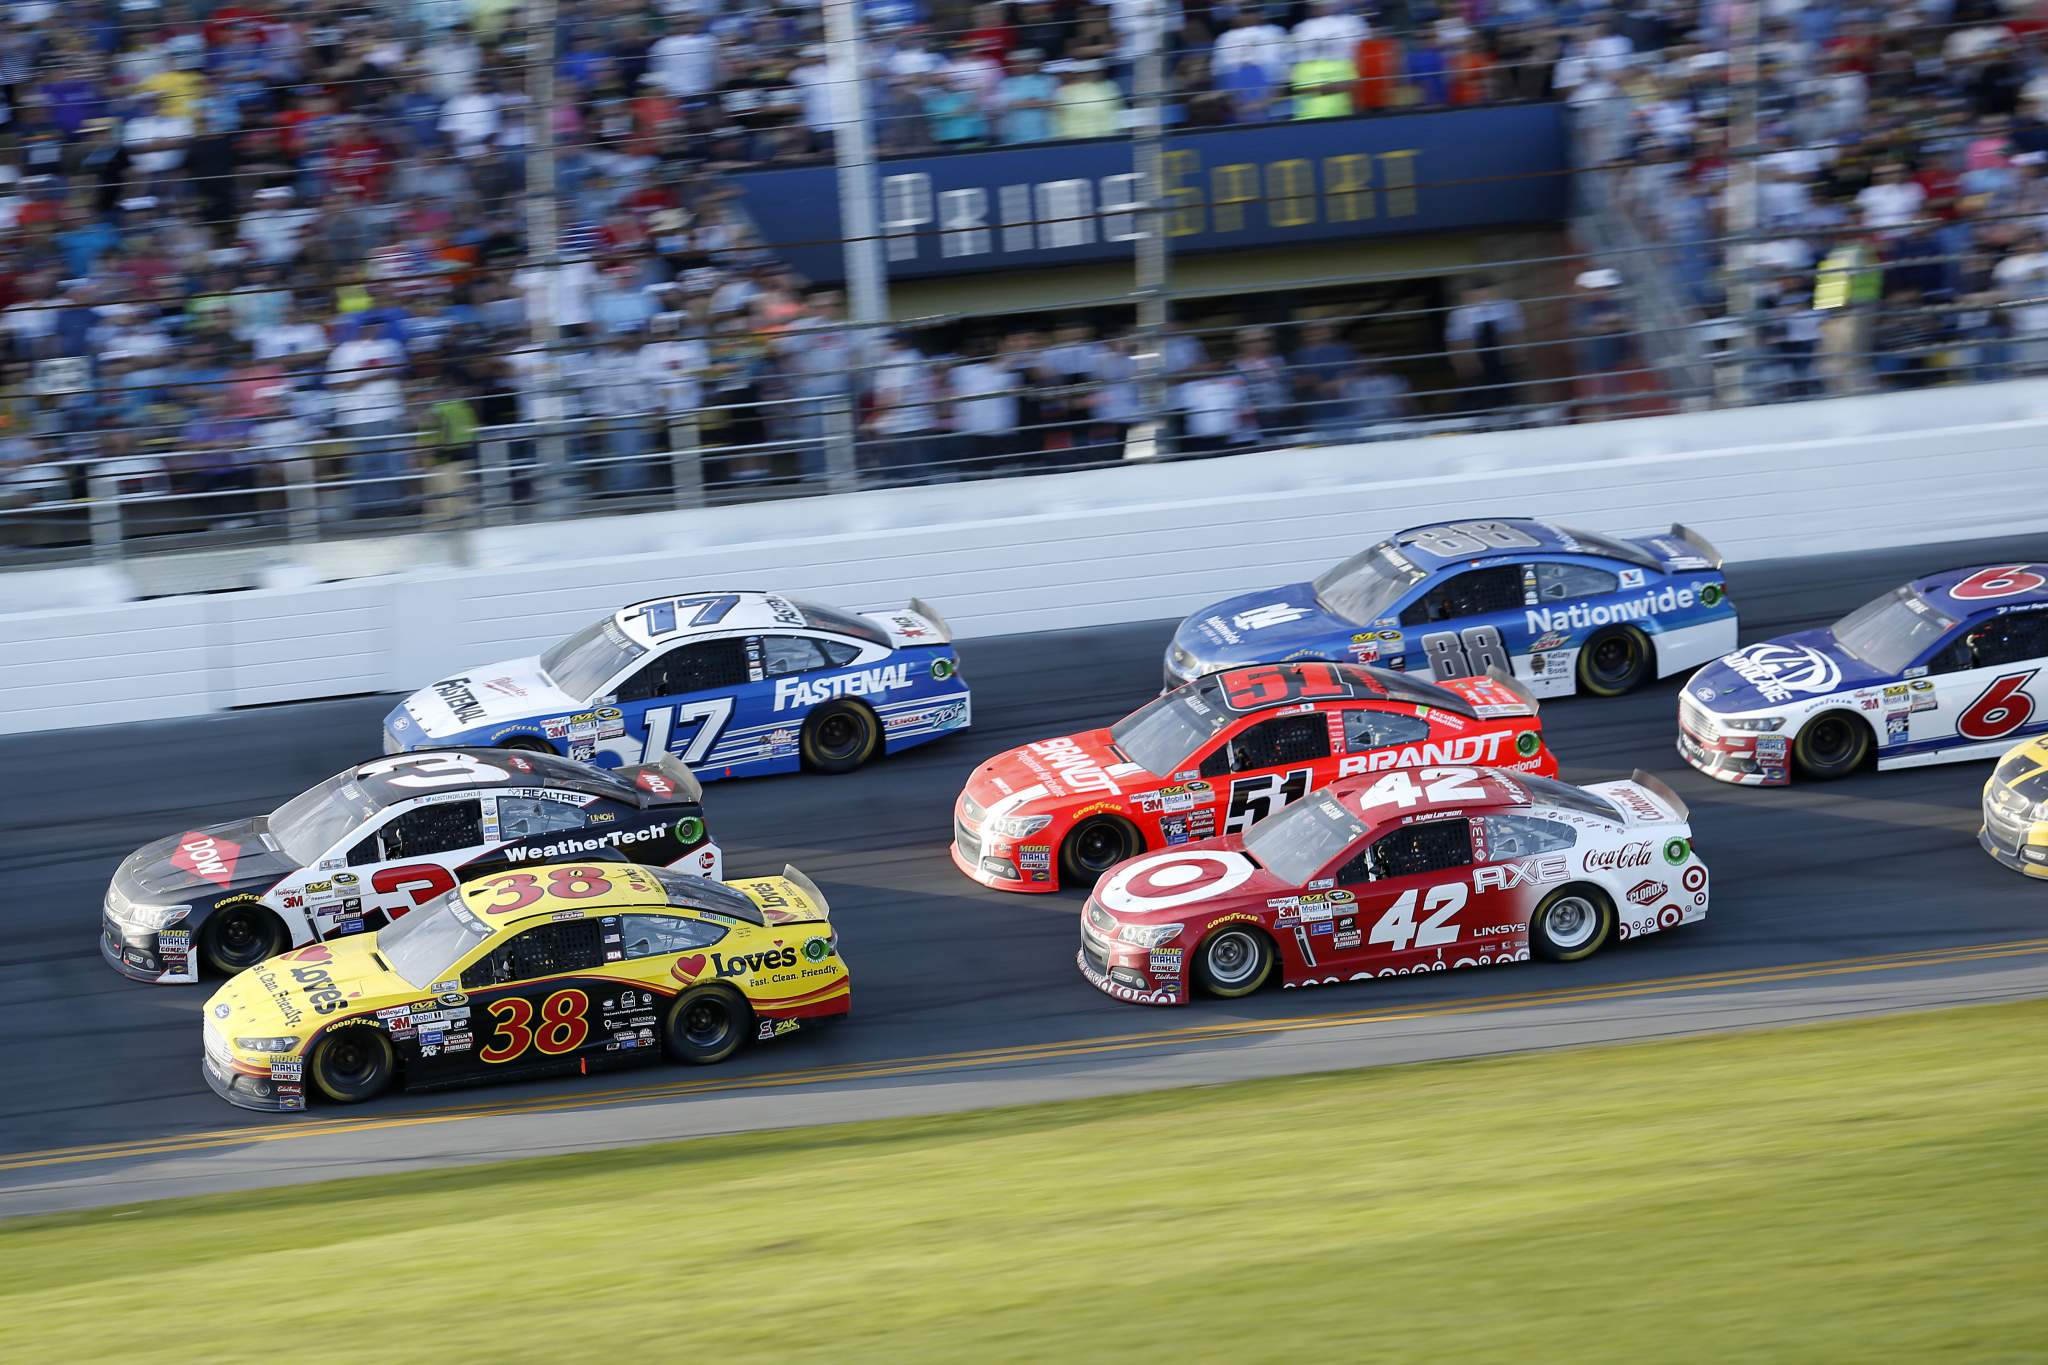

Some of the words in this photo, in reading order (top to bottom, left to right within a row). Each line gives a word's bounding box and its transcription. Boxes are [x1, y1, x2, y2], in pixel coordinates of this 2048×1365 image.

[1400, 521, 1541, 557] 88
[1950, 564, 2046, 600] 6
[639, 595, 741, 637] 17
[1525, 585, 1694, 635] Nationwide
[1421, 624, 1512, 680] 88
[773, 662, 913, 712] FASTENAL
[1221, 663, 1343, 708] 51
[432, 677, 488, 725] FASTENAL
[1861, 698, 1879, 710] 3M
[1956, 667, 2041, 740] 6
[547, 726, 567, 738] 3M
[642, 697, 737, 767] 17
[1338, 730, 1513, 778] BRANDT
[357, 752, 510, 788] 3
[1027, 738, 1122, 795] BRANDT
[642, 773, 672, 793] DOW
[1360, 766, 1486, 811] 42
[522, 788, 587, 803] REALTREE
[1144, 799, 1162, 811] 3M
[1224, 767, 1313, 835] 51
[591, 812, 615, 821] UNOH
[1072, 802, 1122, 819] GOODYEAR
[504, 824, 666, 862] WeatherTech
[182, 838, 228, 875] DOW
[1021, 853, 1049, 861] MAHLE
[1583, 840, 1654, 873] Coca-Cola
[1472, 855, 1571, 894] AXE
[214, 893, 266, 909] GOODYEAR
[485, 866, 613, 914] 38
[1630, 881, 1665, 904] CLOROX
[283, 896, 303, 908] 3M
[1280, 906, 1299, 918] 3M
[1302, 904, 1321, 913] Mobil
[1207, 912, 1259, 929] GOODYEAR
[1368, 882, 1469, 951] 42
[1473, 923, 1526, 937] LINKSYS
[750, 978, 769, 987] Fast.
[772, 974, 798, 984] Clean.
[801, 965, 838, 979] Friendly.
[326, 1017, 380, 1033] GOODYEAR
[378, 1009, 396, 1018] Holley
[390, 1017, 410, 1031] 3M
[412, 1013, 433, 1022] Mobil
[775, 1017, 798, 1031] ZAK
[479, 988, 590, 1063] 38
[270, 1055, 302, 1063] MOOG
[272, 1064, 301, 1072] MAHLE
